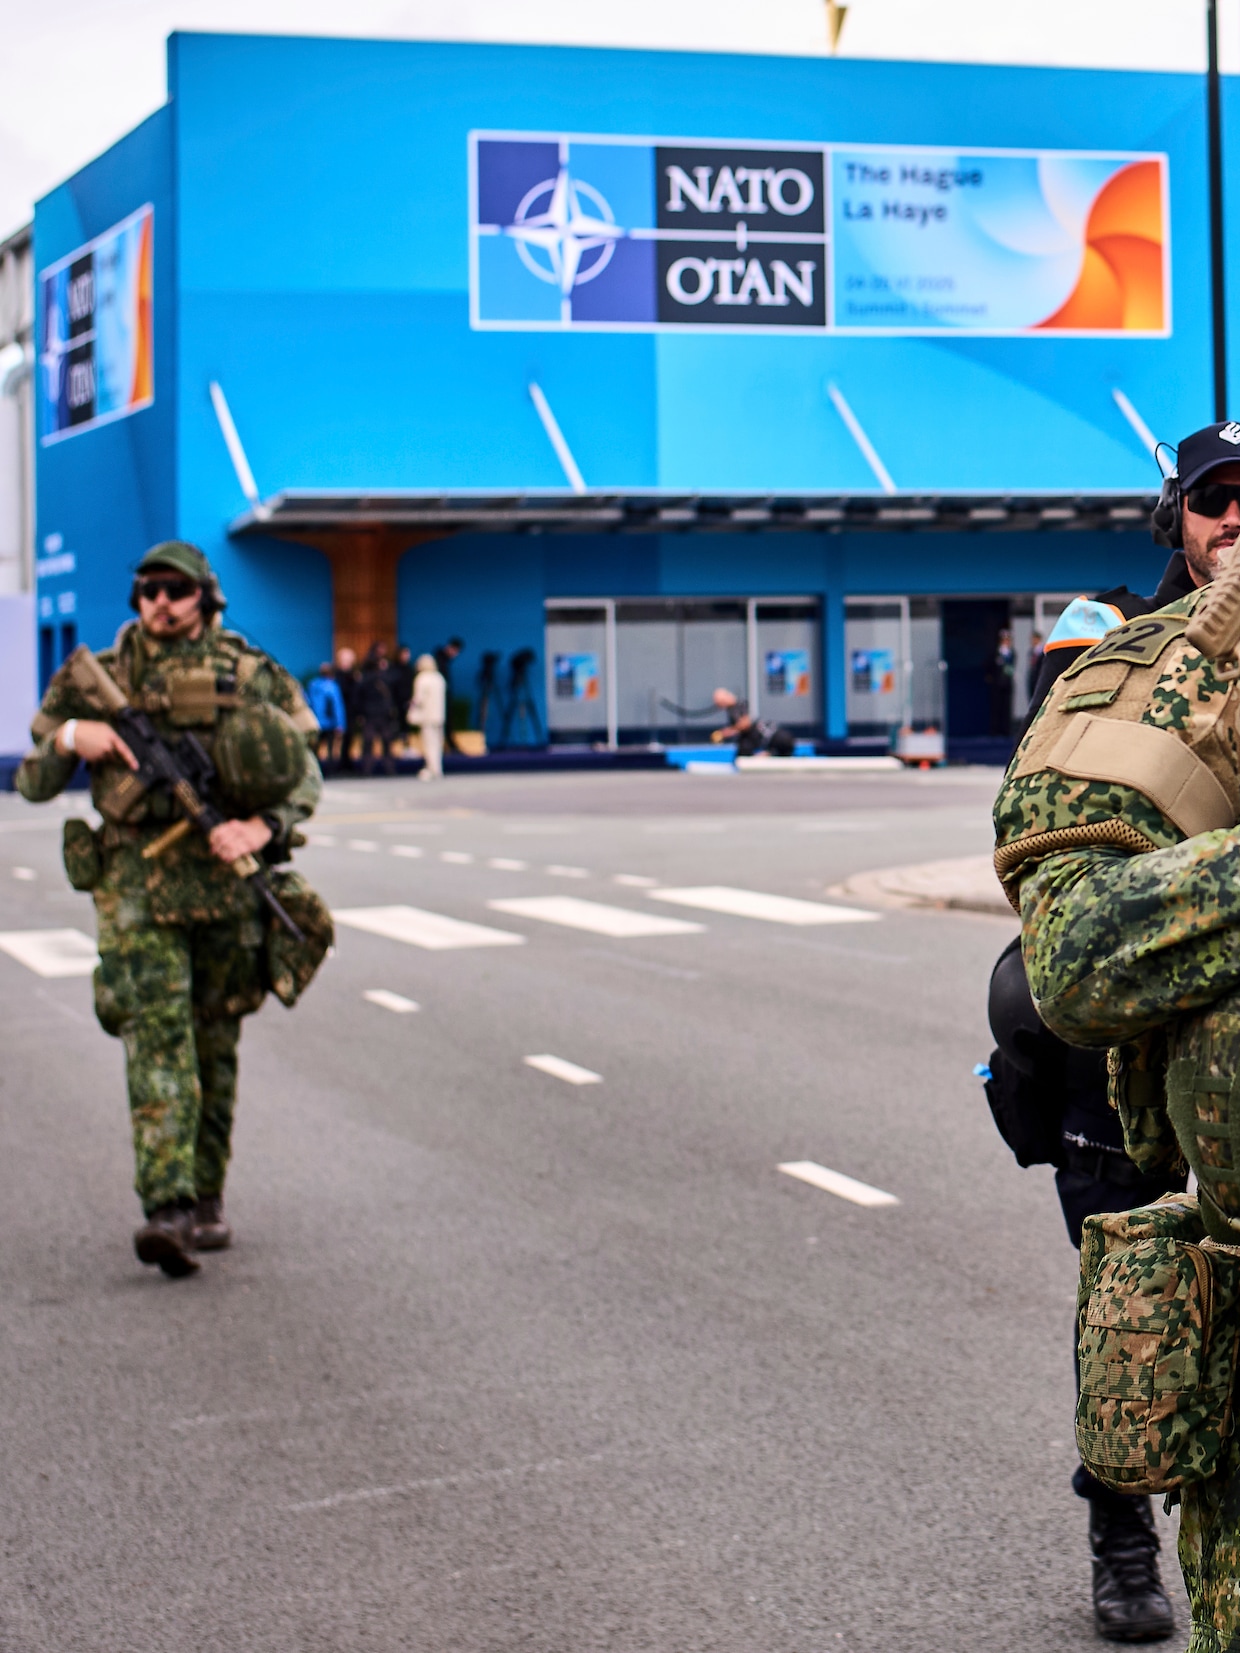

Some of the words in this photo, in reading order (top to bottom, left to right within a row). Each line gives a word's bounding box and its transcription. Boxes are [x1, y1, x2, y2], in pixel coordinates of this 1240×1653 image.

[665, 165, 815, 216] NATO
[845, 163, 890, 183] The
[902, 165, 983, 192] Hague
[843, 200, 872, 220] La
[882, 202, 947, 227] Haye
[666, 256, 816, 307] OTAN
